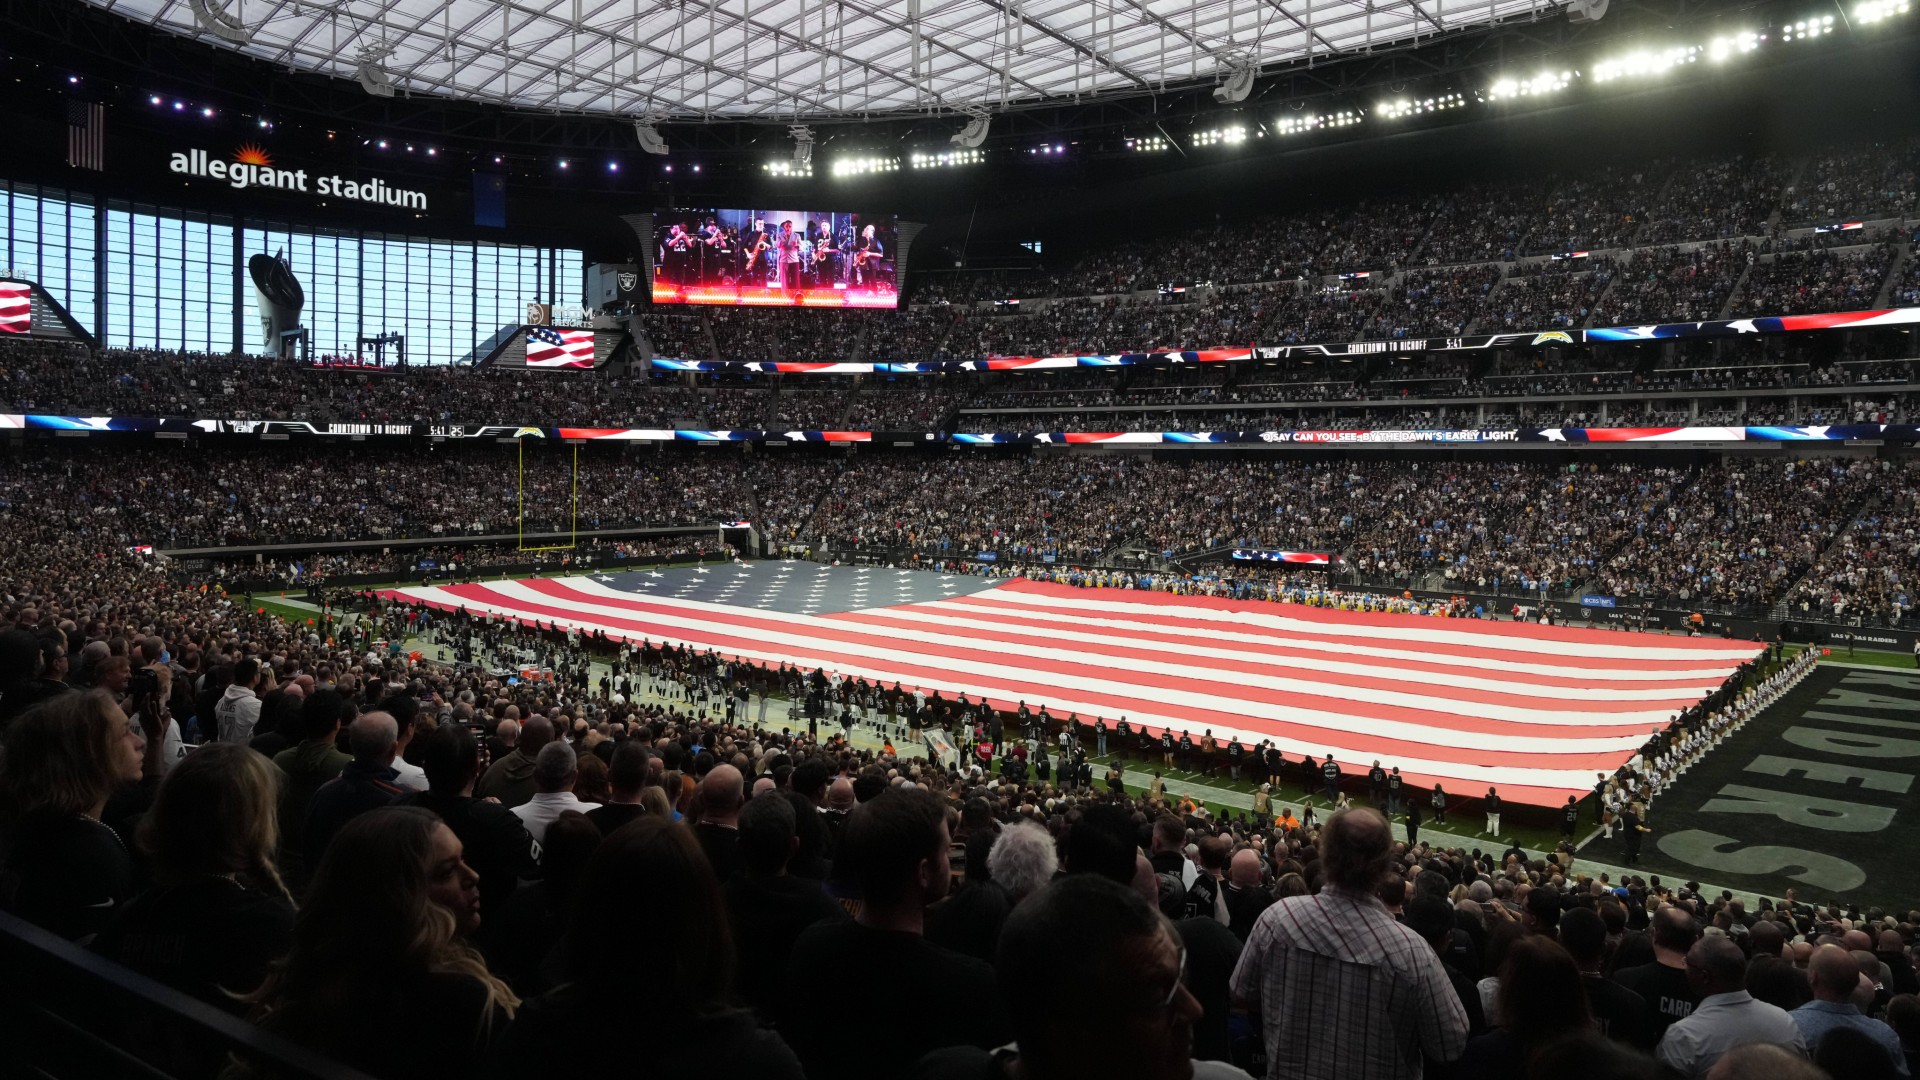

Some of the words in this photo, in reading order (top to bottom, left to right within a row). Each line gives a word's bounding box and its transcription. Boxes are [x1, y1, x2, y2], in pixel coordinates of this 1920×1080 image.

[170, 148, 307, 191] allegiant
[317, 175, 427, 210] stadium
[551, 304, 593, 319] MGM
[1348, 342, 1387, 354] COUNTDOWN
[1389, 341, 1398, 352] TO
[1400, 340, 1428, 351] KICKOFF
[1446, 338, 1462, 349] 5:41
[328, 423, 371, 435] COUNTDOWN
[374, 424, 382, 434] TO
[385, 424, 412, 435] KICKOFF
[430, 425, 445, 436] 5:41
[1273, 432, 1292, 442] SAY
[1293, 432, 1314, 441] CAN
[1316, 432, 1337, 441] YOU
[1380, 431, 1401, 441] THE
[1445, 431, 1480, 441] EARLY
[1867, 636, 1898, 644] RAIDERS
[1656, 671, 1920, 893] RAIDERS
[1660, 996, 1692, 1018] CARR
